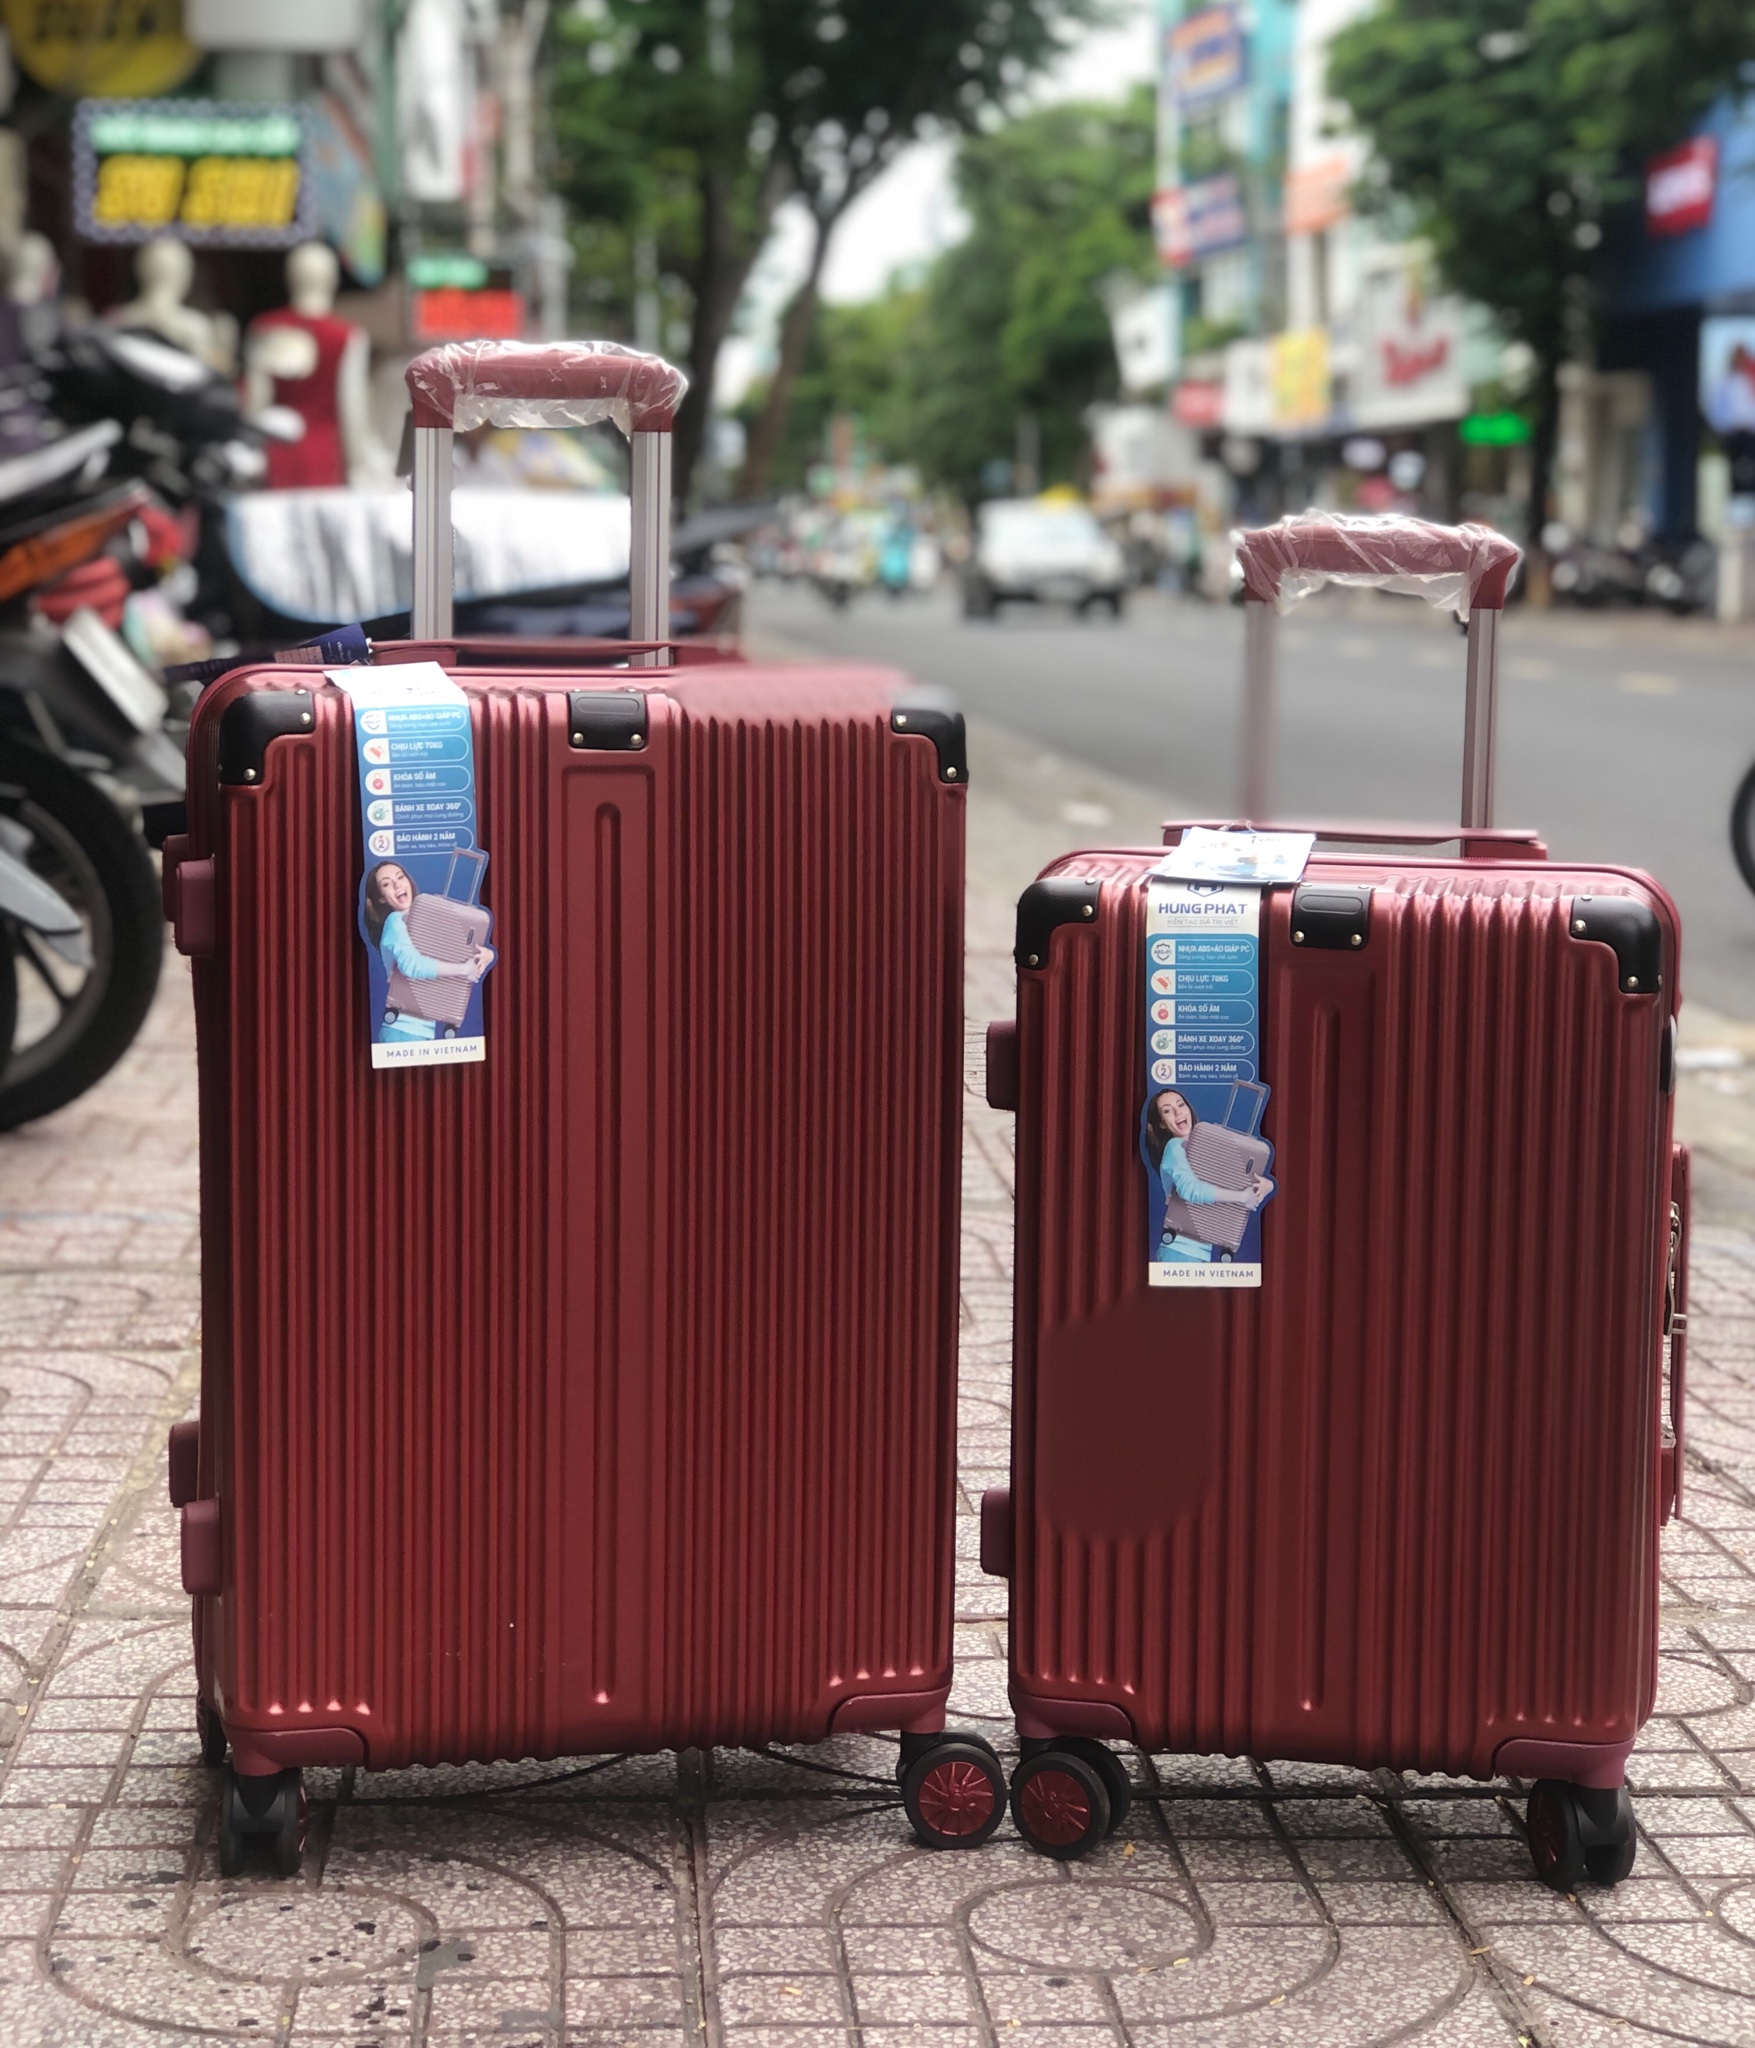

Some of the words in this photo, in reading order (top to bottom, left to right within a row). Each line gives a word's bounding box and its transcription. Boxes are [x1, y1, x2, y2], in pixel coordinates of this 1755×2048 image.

[1178, 945, 1196, 954] NHỰA
[1224, 944, 1240, 952] GIÁP
[1240, 945, 1250, 953] PC
[1178, 975, 1194, 984] CHỊU
[1196, 975, 1210, 984] LỰC
[1178, 1004, 1197, 1012] KHÓA
[1198, 1003, 1208, 1012] SỐ
[1178, 1034, 1198, 1042] BÁNH
[386, 1049, 414, 1058] MADE
[419, 1048, 430, 1056] IN
[434, 1045, 478, 1055] VIETNAM
[1178, 1062, 1192, 1072] BẢO
[1194, 1062, 1214, 1072] HÀNH
[1215, 1064, 1220, 1072] 2
[1220, 1062, 1237, 1072] NĂM
[1210, 1270, 1254, 1278] VIETNAM
